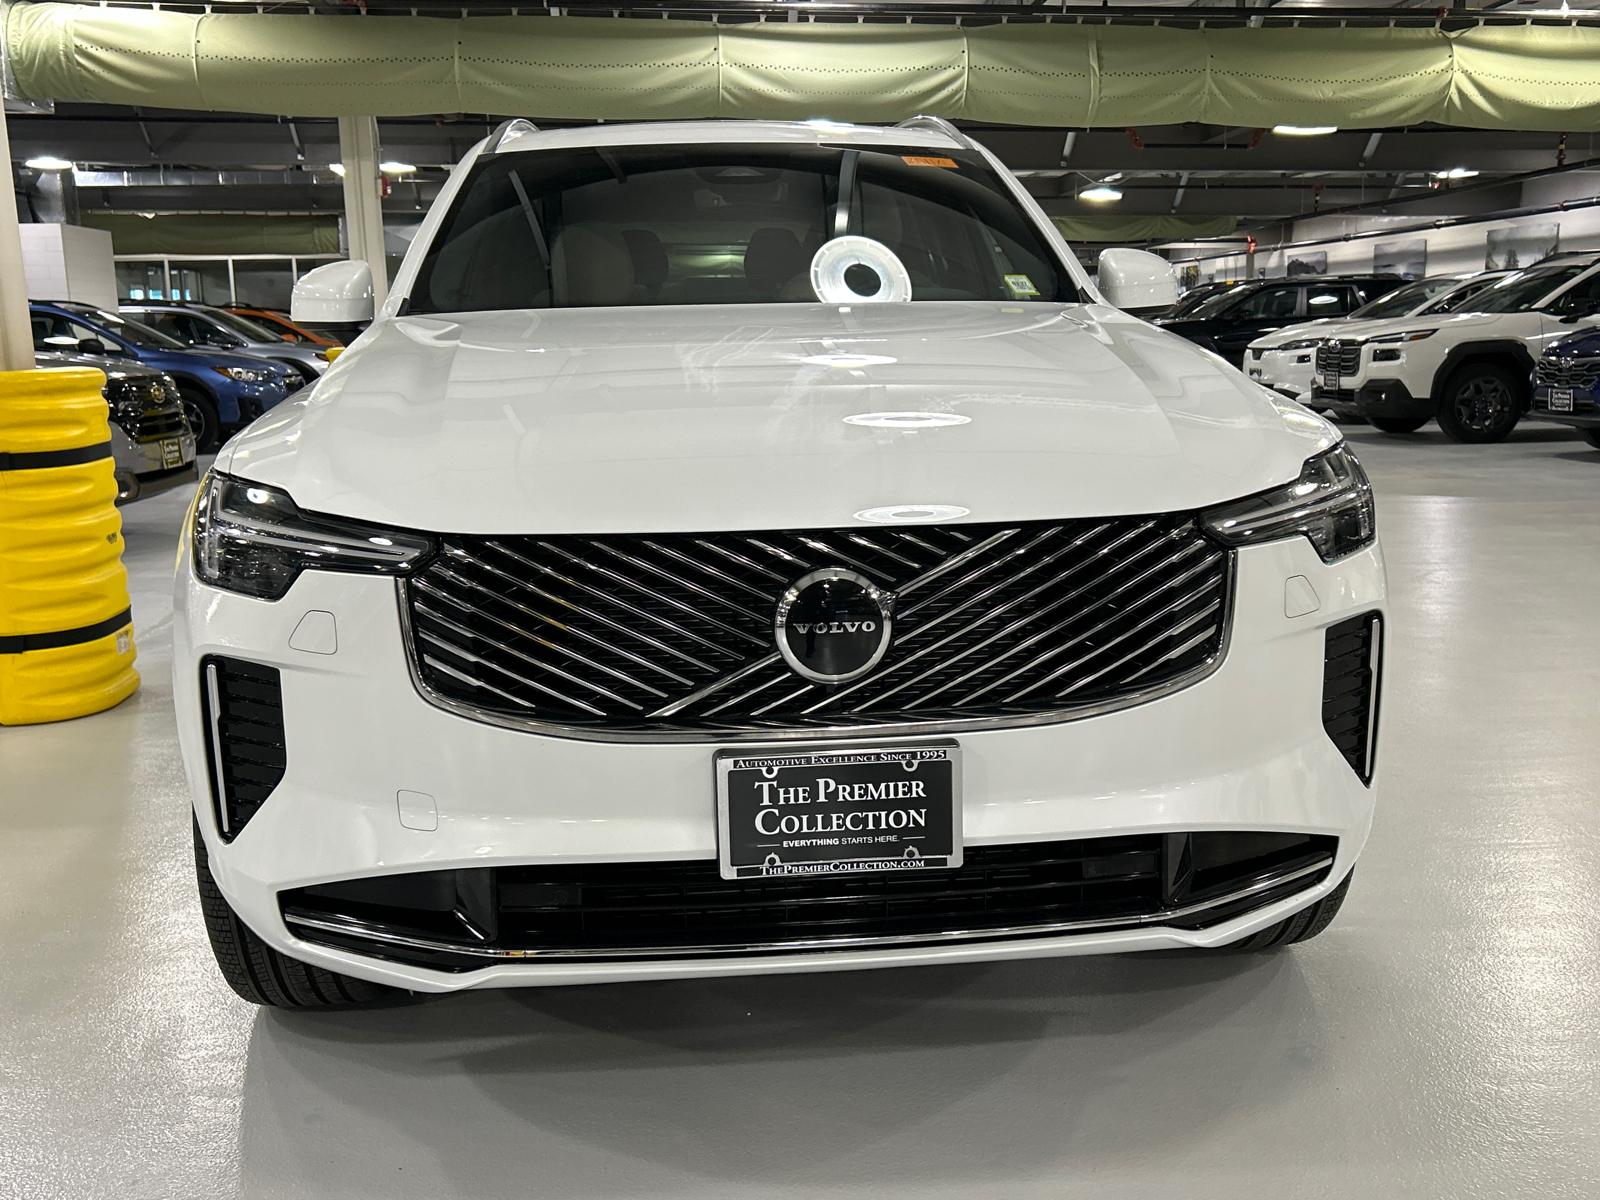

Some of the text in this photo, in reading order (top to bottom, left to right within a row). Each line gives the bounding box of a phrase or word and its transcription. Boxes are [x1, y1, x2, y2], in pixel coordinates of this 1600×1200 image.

[793, 621, 876, 634] VOLVO
[916, 750, 945, 760] 1995
[754, 778, 927, 806] THE PREMIER
[754, 808, 927, 835] COLLECTION
[783, 835, 900, 848] EVERYTHING STARTS HERE.
